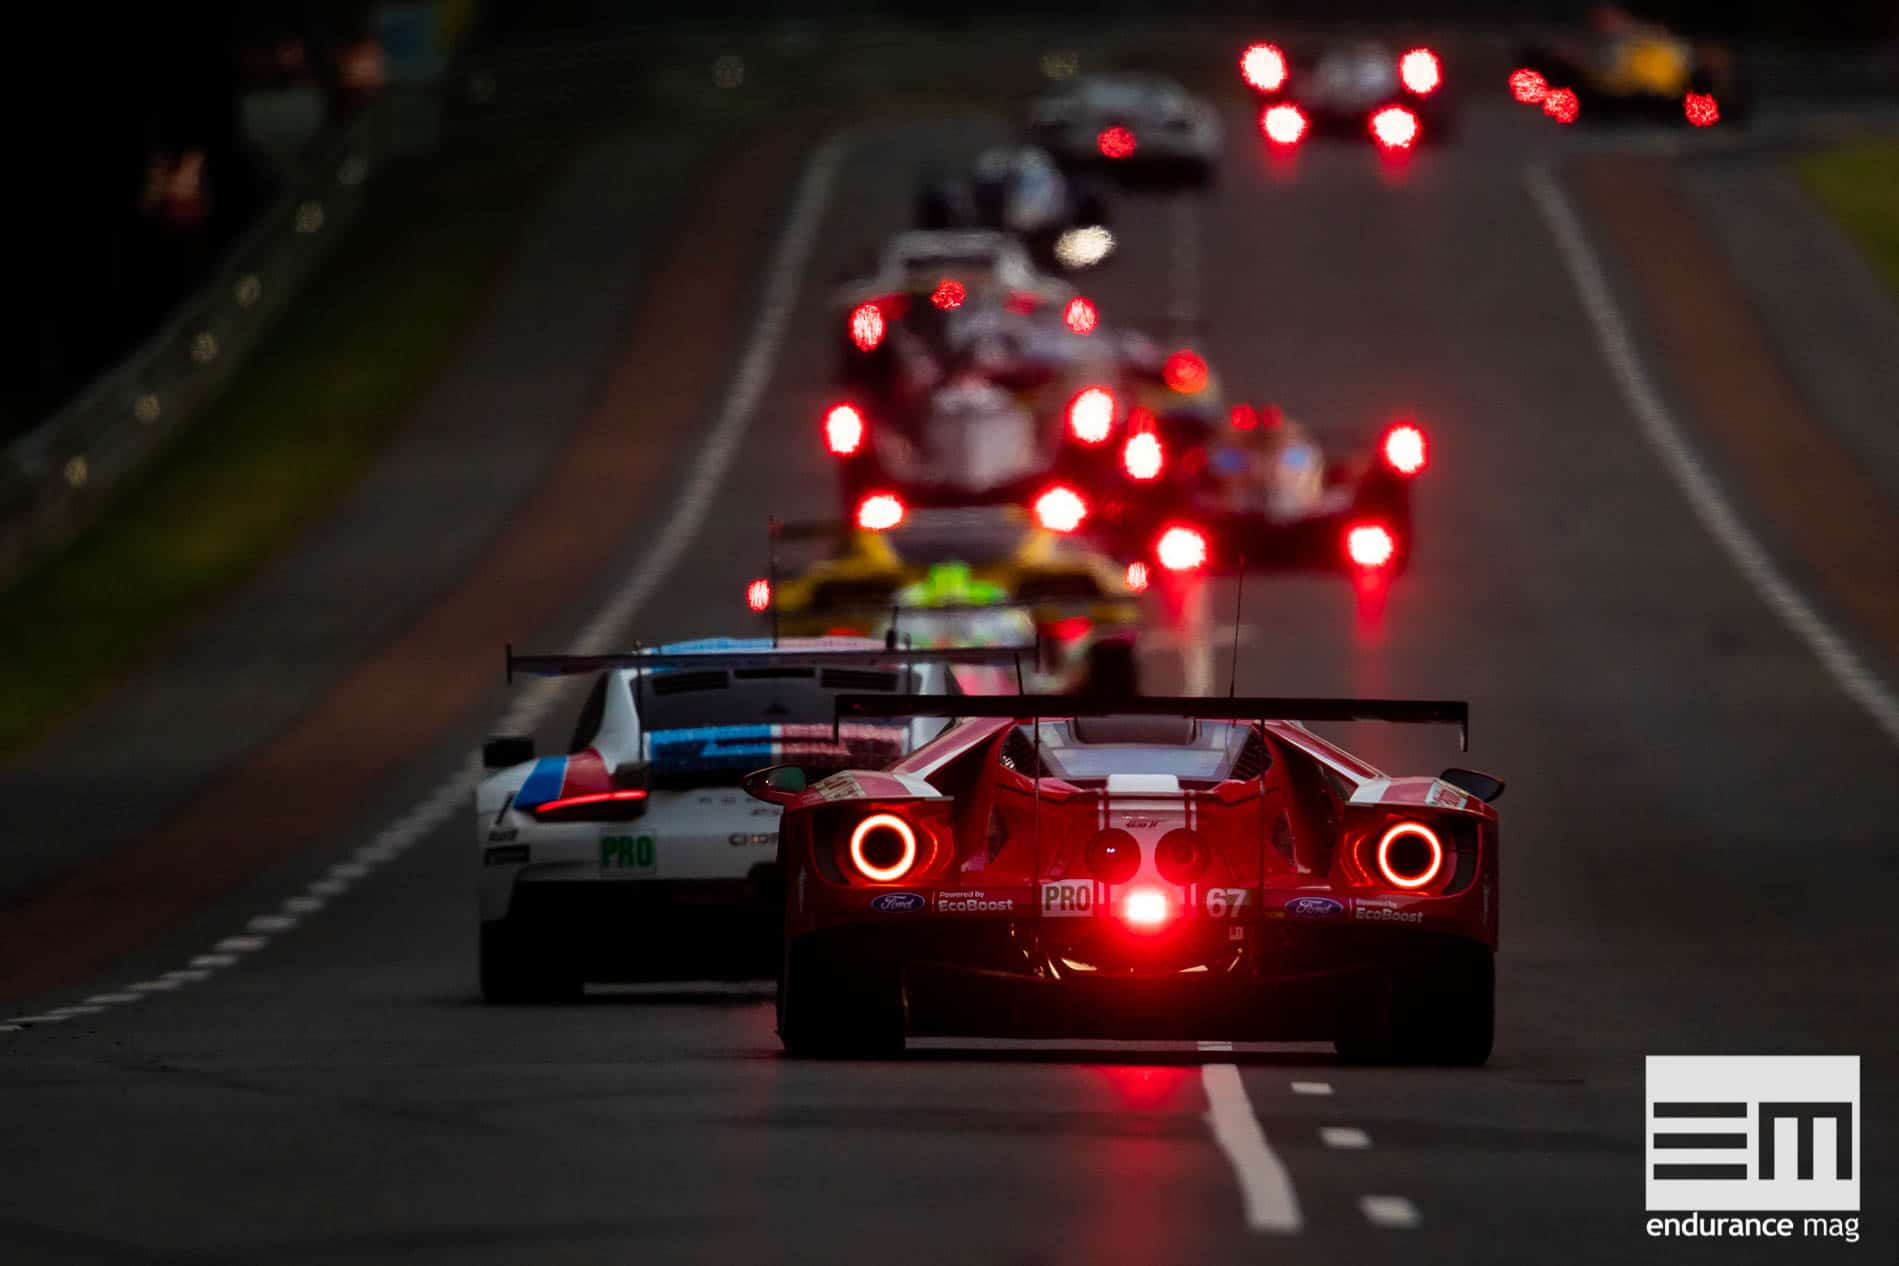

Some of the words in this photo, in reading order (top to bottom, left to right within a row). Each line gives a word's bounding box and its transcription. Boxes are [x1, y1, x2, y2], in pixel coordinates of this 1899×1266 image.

[601, 836, 654, 867] PRO
[938, 898, 1014, 912] EcoBoost
[1045, 886, 1091, 912] PRO
[1205, 887, 1248, 919] 67
[1355, 907, 1424, 924] EcoBoost
